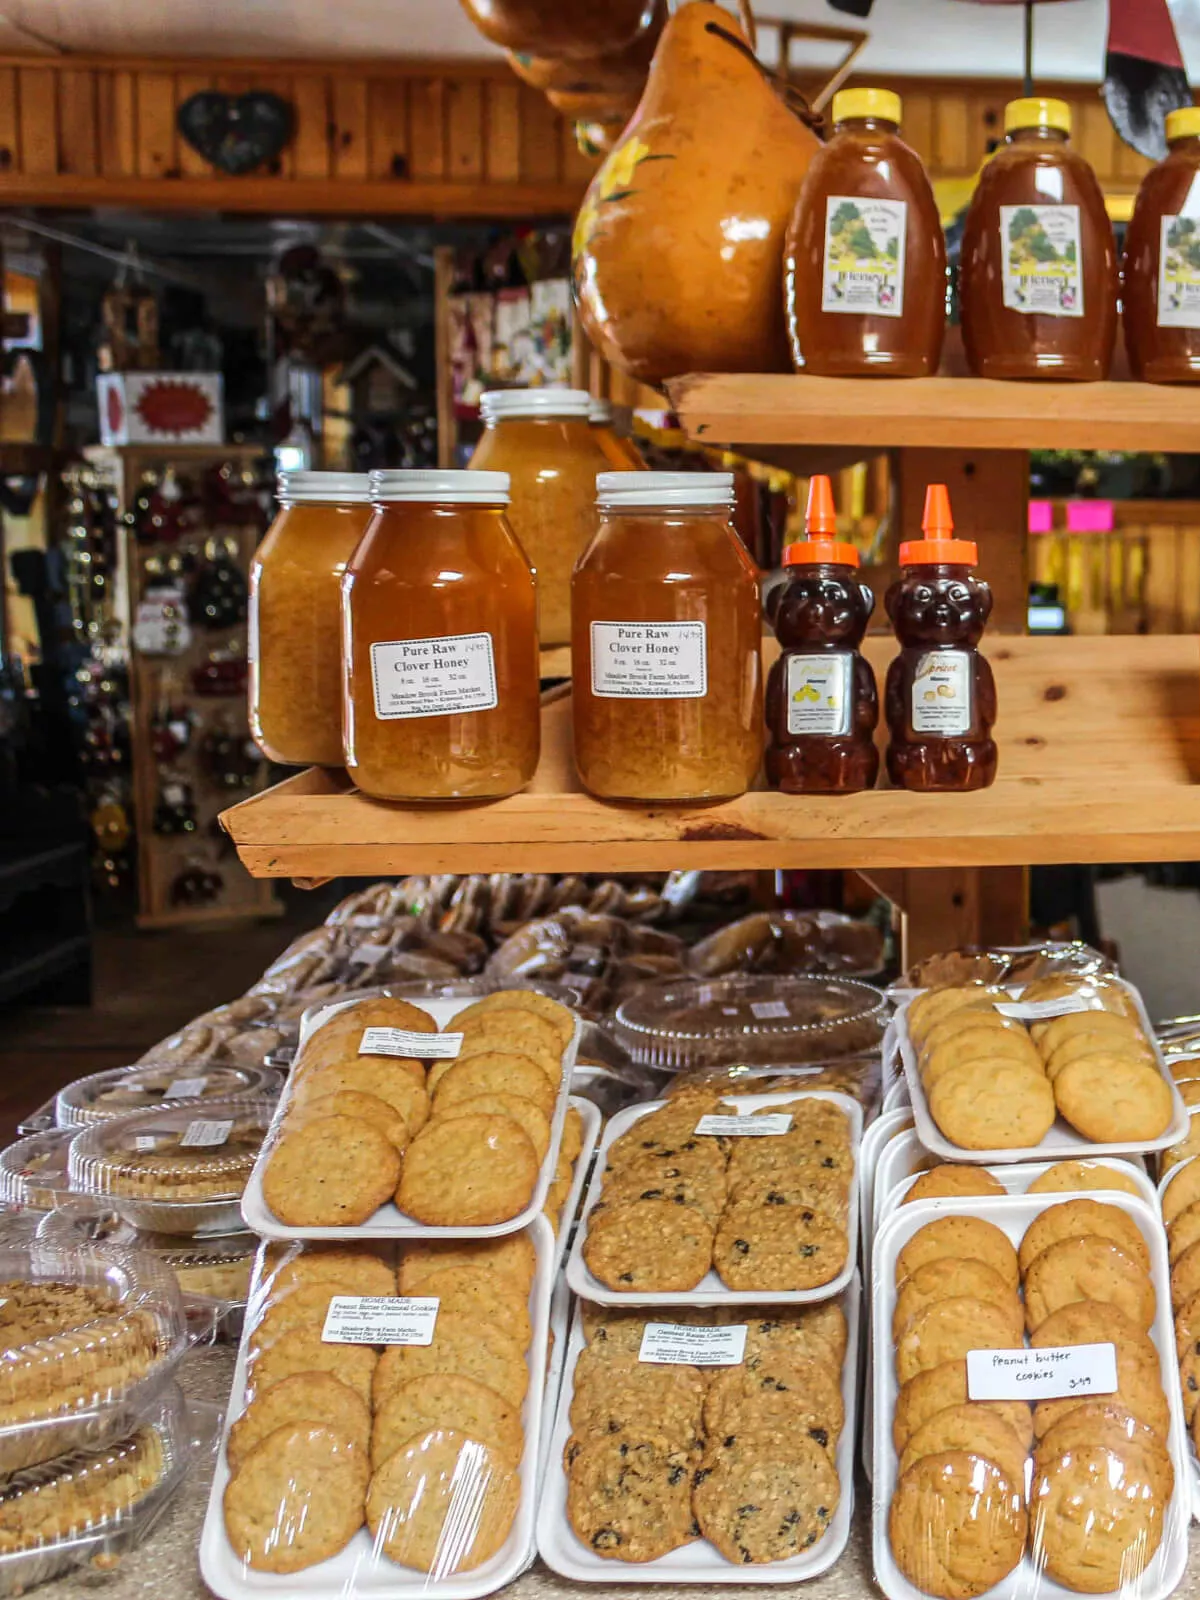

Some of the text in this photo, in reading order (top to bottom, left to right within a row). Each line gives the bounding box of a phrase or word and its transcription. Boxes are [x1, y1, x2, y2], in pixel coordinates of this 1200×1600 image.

[618, 628, 670, 639] Pure Raw
[402, 644, 456, 657] Pure Raw
[609, 642, 681, 655] Clover Honey
[394, 658, 470, 673] Clover Honey
[1036, 1352, 1072, 1363] butter
[1016, 1369, 1054, 1382] cookies
